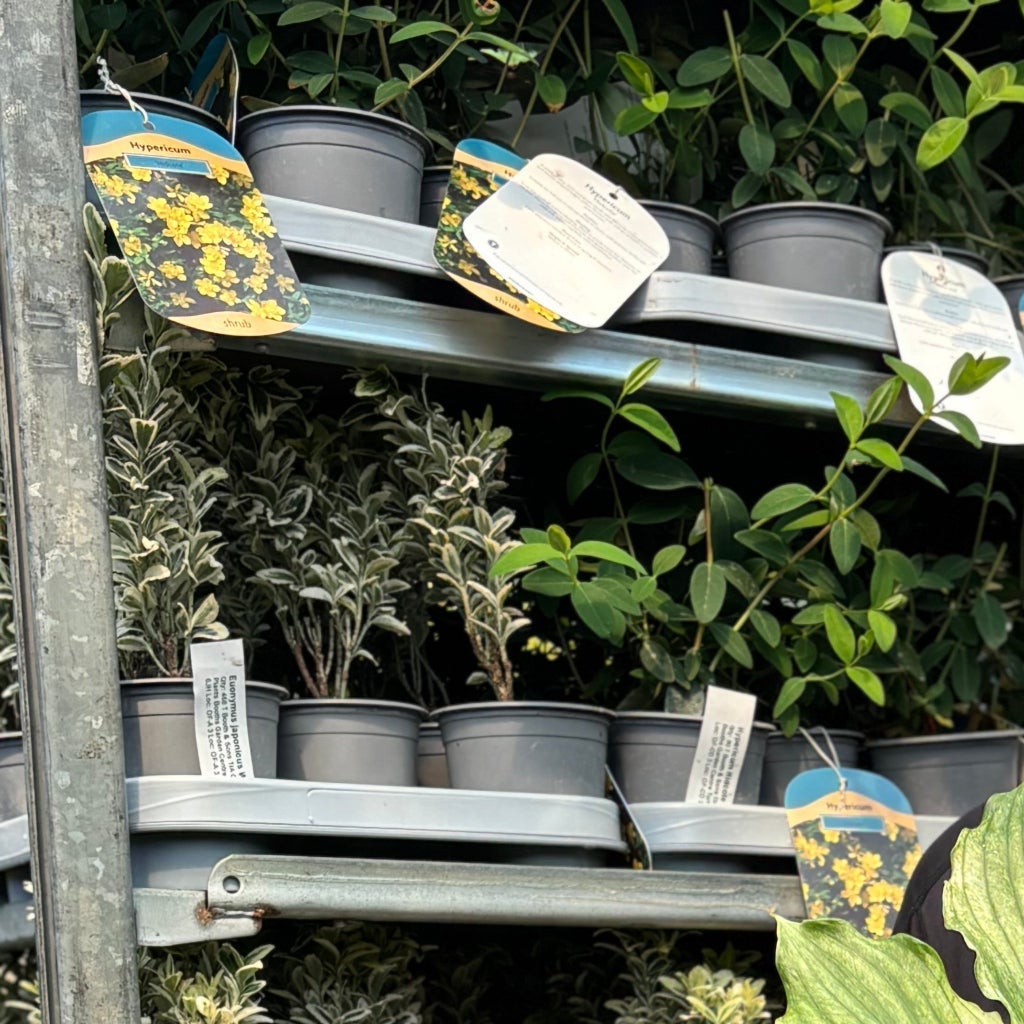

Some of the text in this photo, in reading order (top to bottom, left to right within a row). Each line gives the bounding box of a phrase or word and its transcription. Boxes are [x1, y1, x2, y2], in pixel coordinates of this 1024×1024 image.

[129, 141, 191, 155] Hypericum
[493, 293, 521, 313] shrub
[222, 317, 253, 330] shrub
[228, 675, 238, 723] Euonymus
[216, 726, 224, 752] Garden
[230, 725, 244, 770] japonicus
[219, 754, 227, 776] Centre
